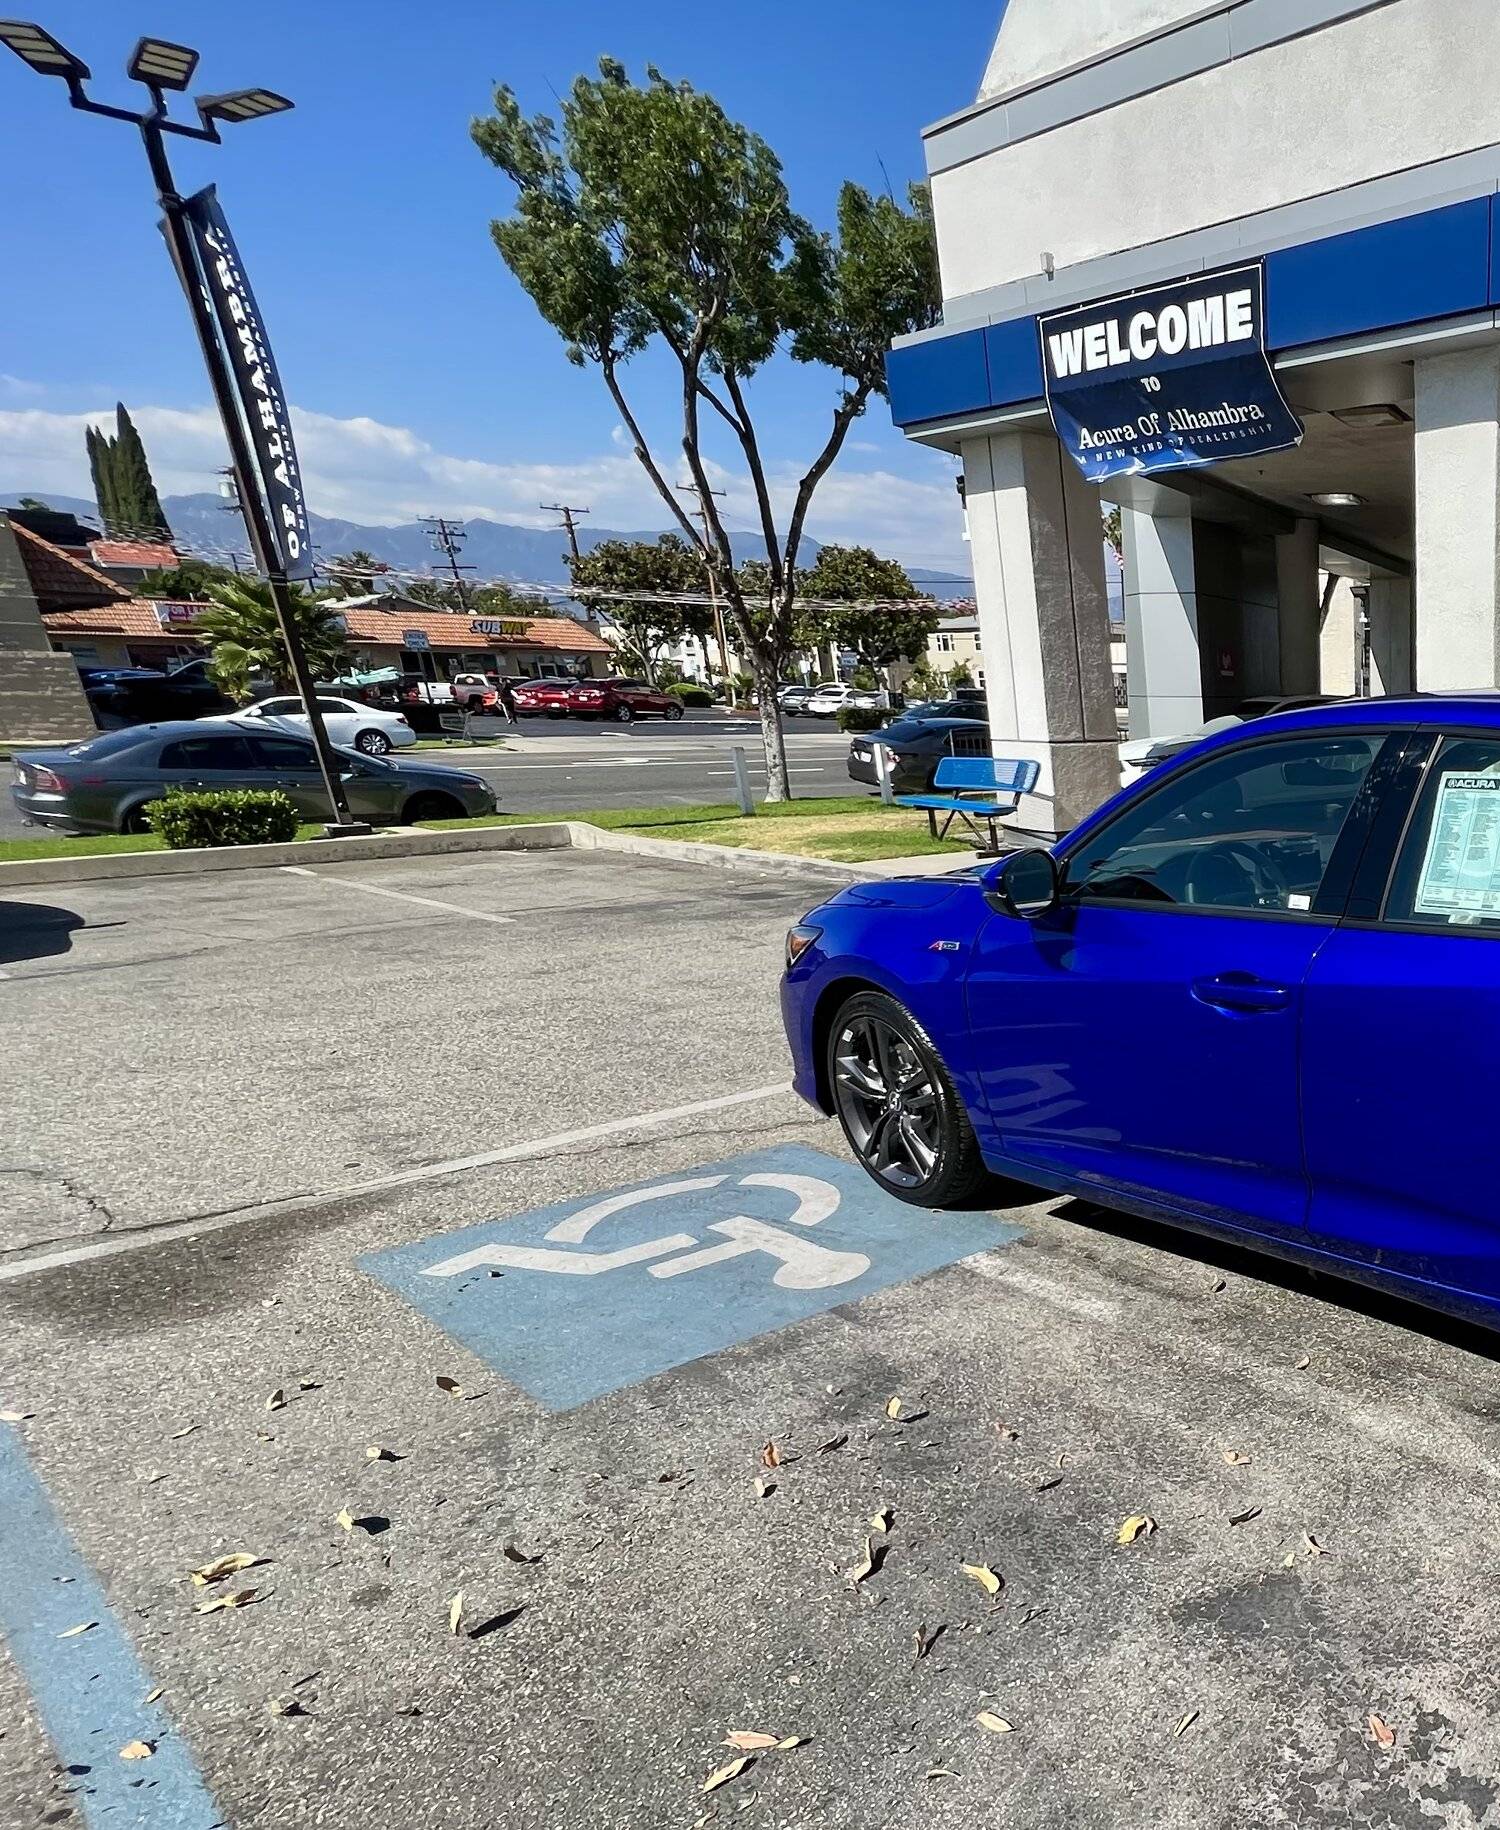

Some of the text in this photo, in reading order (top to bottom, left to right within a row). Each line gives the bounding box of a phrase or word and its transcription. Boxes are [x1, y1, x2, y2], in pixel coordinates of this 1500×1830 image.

[205, 224, 291, 489] ALHAMBRA
[1049, 289, 1254, 378] WELCOME
[1140, 376, 1161, 393] TO
[280, 424, 296, 476] KIND
[1078, 402, 1265, 450] Acura Of Alhambra
[1095, 448, 1127, 462] NEW
[1132, 441, 1163, 457] KIND
[1189, 423, 1274, 445] DEALERSHIP
[281, 503, 300, 559] OF
[470, 620, 536, 635] SUBWAY
[1456, 779, 1496, 789] ACURA
